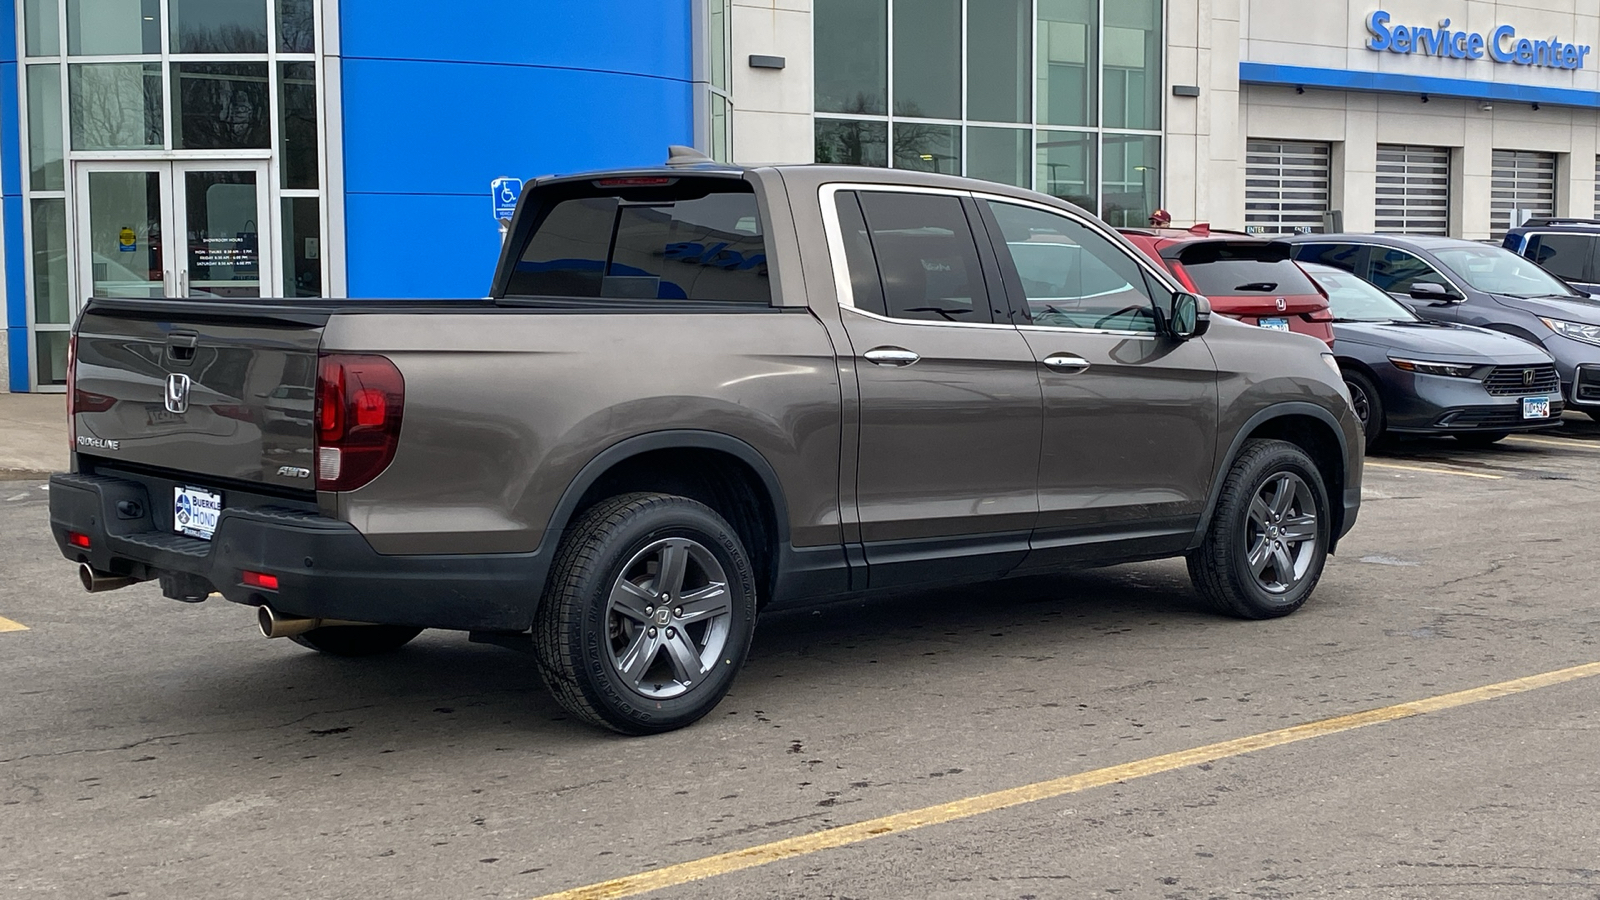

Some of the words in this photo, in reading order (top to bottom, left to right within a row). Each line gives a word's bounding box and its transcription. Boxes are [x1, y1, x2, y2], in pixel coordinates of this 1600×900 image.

[1365, 10, 1484, 60] Service
[1487, 25, 1591, 70] Center
[77, 435, 120, 450] RIDGELINE
[276, 465, 310, 478] AWD
[192, 495, 221, 510] BUERKLE
[192, 507, 217, 528] HOND
[718, 531, 752, 622] YOKOHAMA
